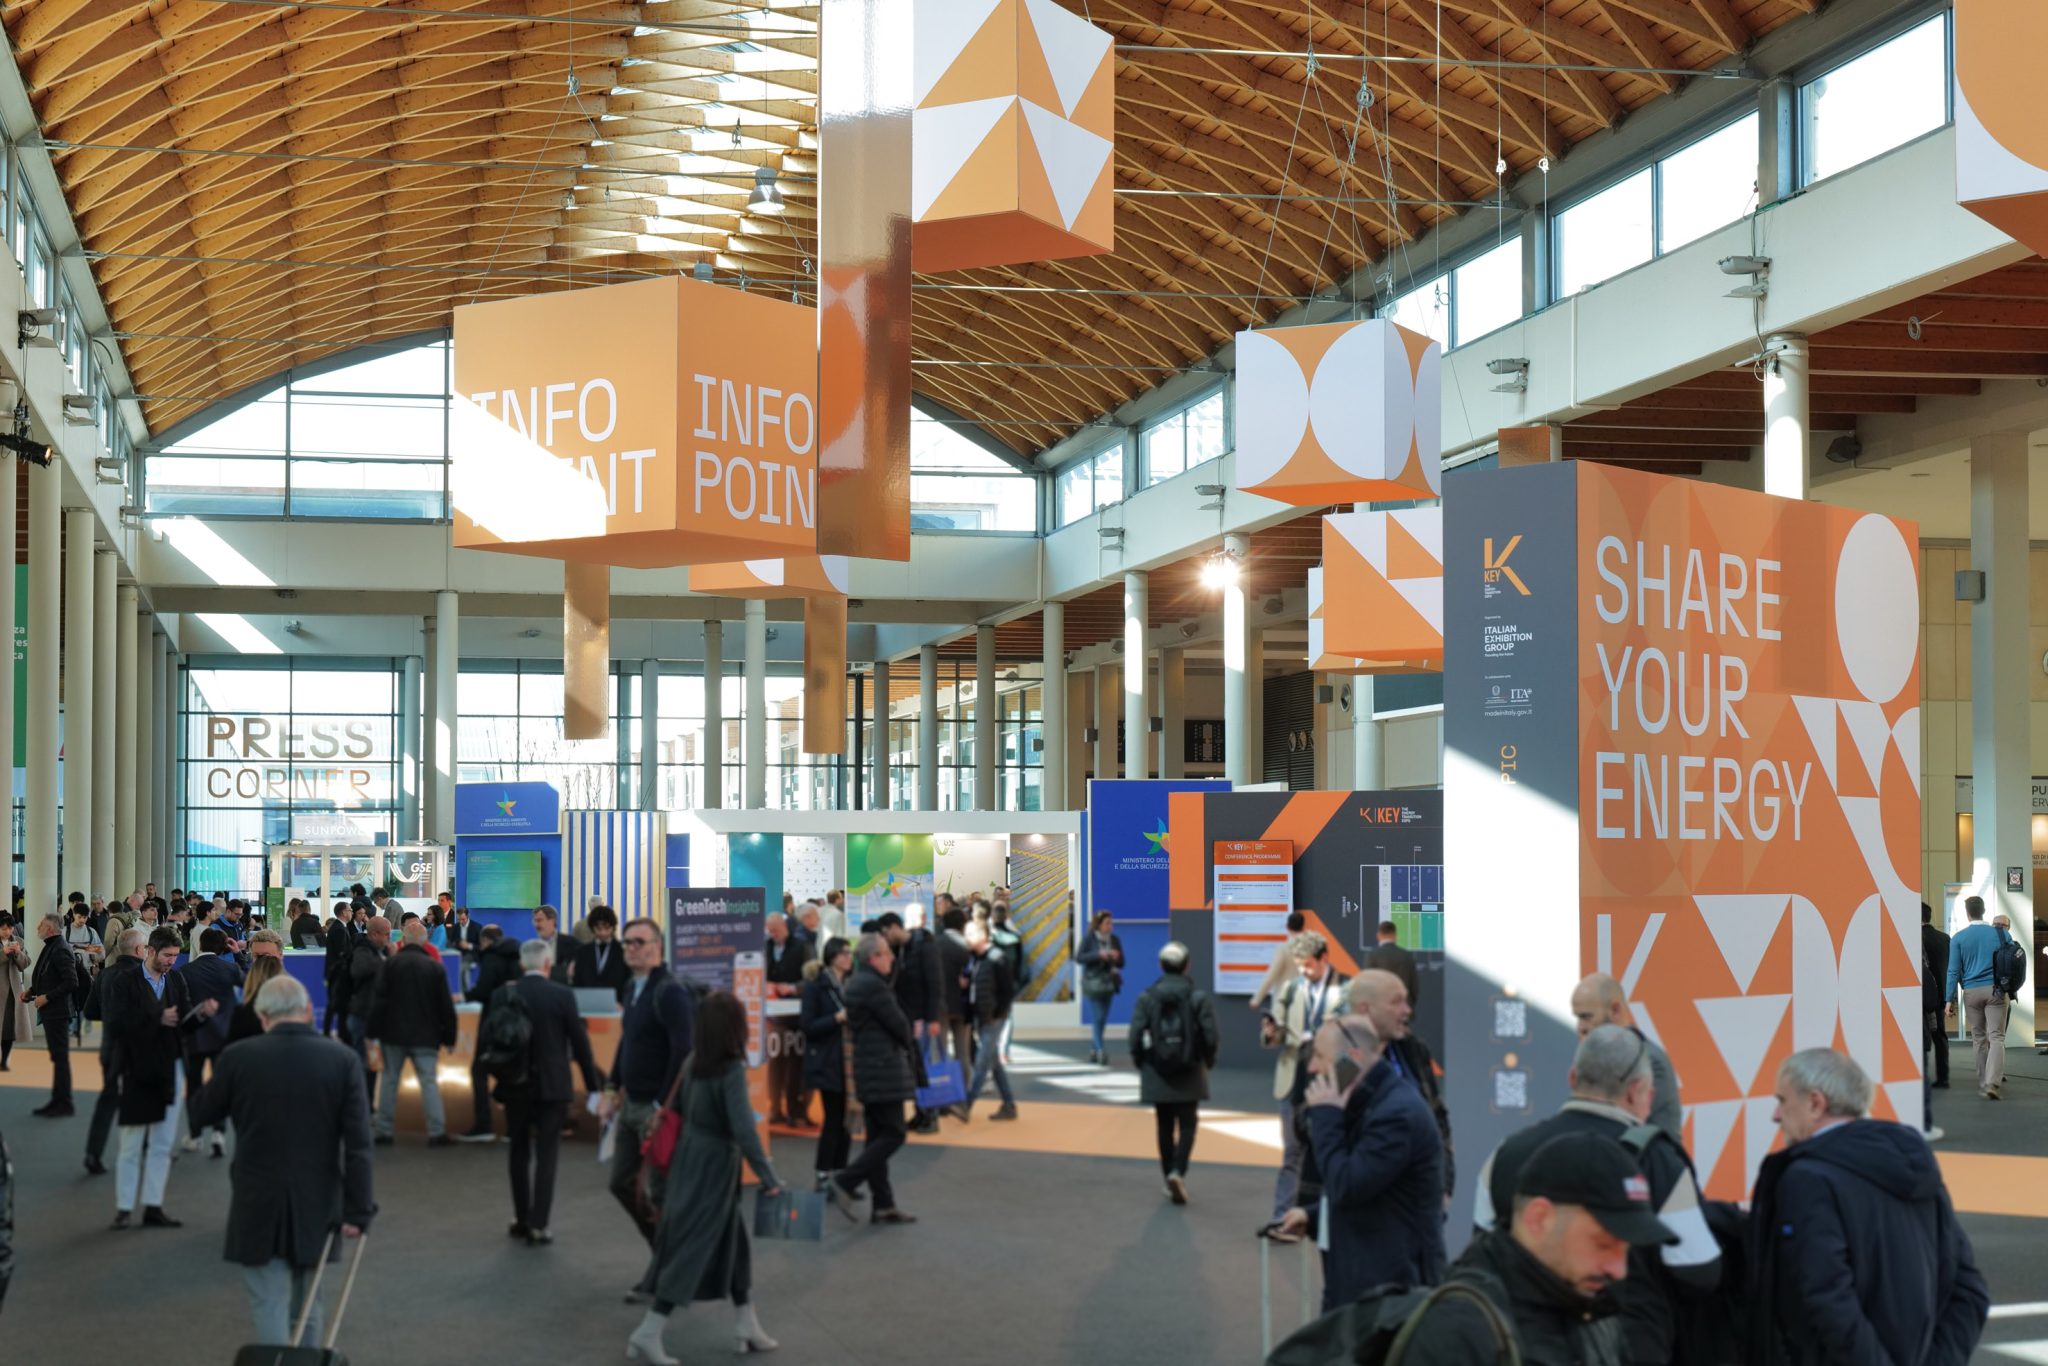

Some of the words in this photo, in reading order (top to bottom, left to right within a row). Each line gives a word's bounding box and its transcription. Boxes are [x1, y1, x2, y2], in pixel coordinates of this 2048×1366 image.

[694, 374, 814, 454] INFO
[695, 450, 814, 528] POIN
[1484, 569, 1501, 583] KEY
[1595, 535, 1782, 641] SHARE
[1484, 625, 1517, 634] ITALIAN
[1484, 632, 1532, 643] EXHIBITION
[1484, 643, 1514, 652] GROUP
[1511, 688, 1529, 699] ITA
[1596, 643, 1750, 739] YOUR
[207, 717, 373, 758] PRESS
[1595, 751, 1812, 841] ENERGY
[1377, 807, 1400, 823] KEY
[411, 862, 432, 873] GSE
